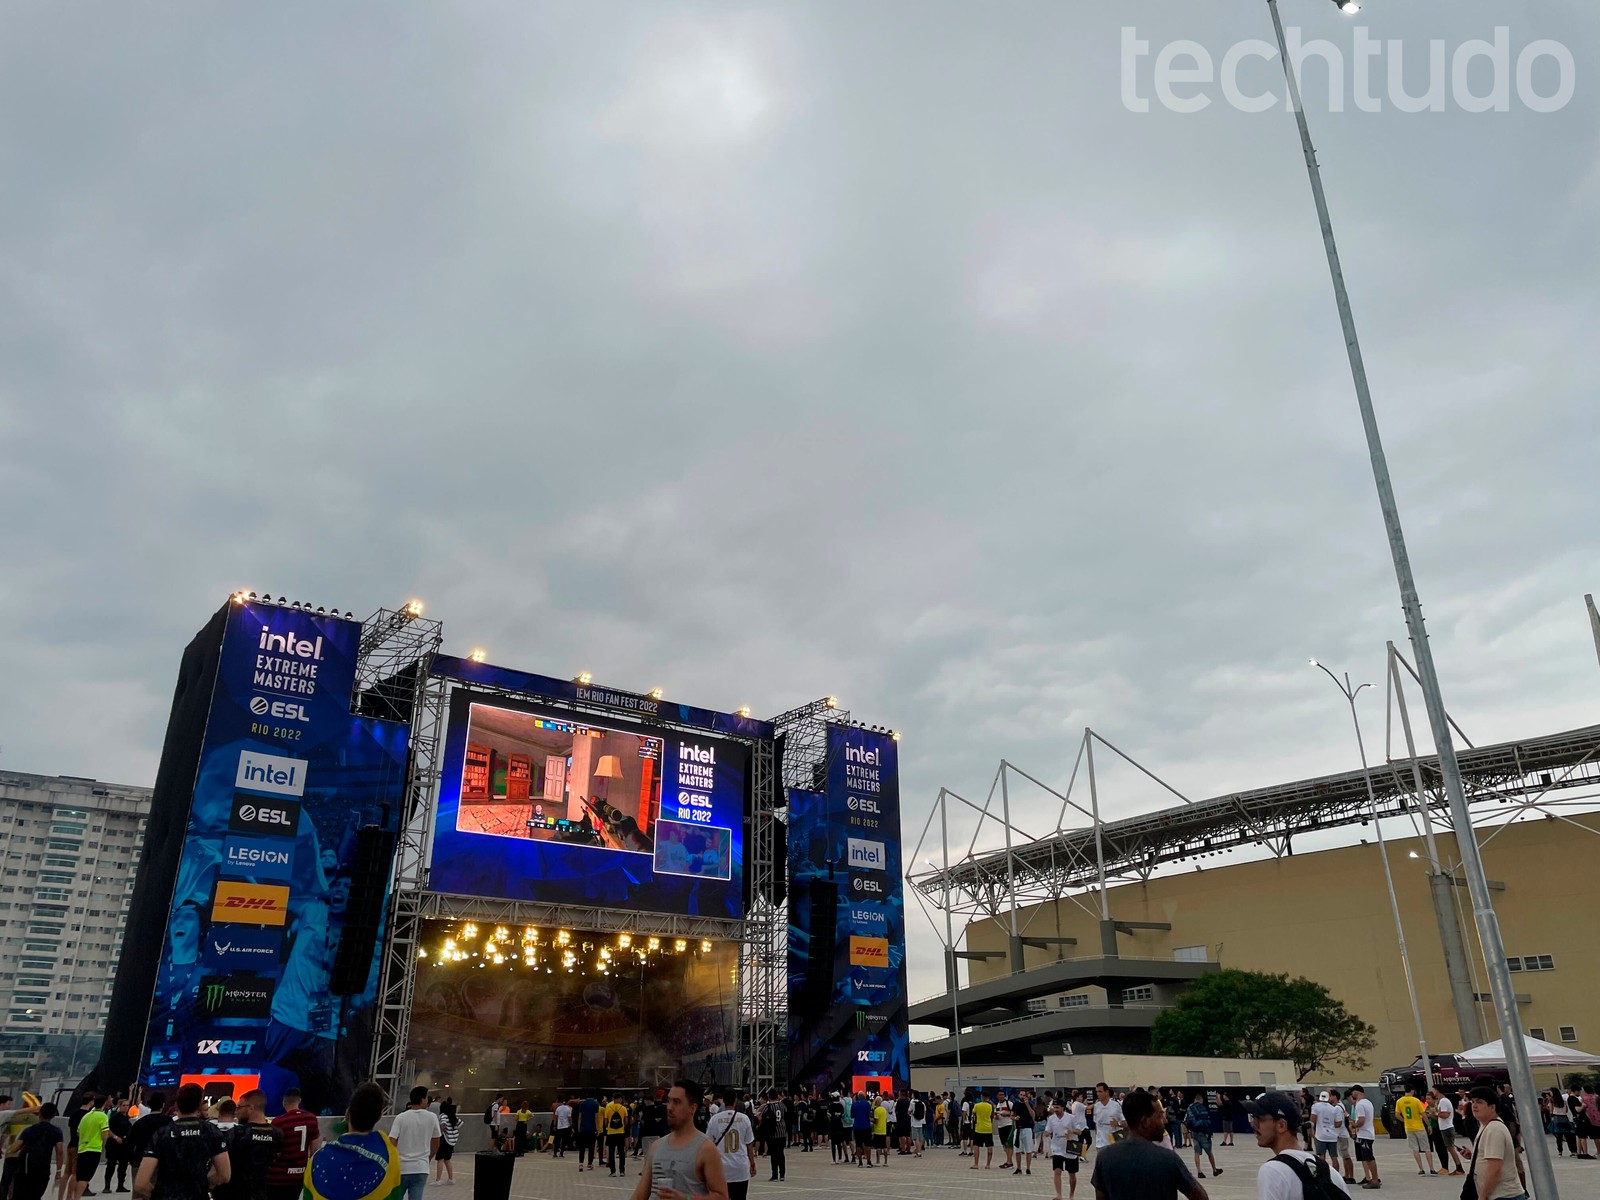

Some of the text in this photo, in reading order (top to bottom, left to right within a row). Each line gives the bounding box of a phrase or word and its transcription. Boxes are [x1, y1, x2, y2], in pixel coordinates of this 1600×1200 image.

[259, 626, 322, 660] intel
[256, 655, 318, 678] EXTREME
[253, 672, 315, 694] MASTERS
[576, 688, 657, 712] IEM RIO FAN FEST 2022
[271, 702, 310, 722] ESL
[251, 723, 302, 740] RIO 2022
[680, 742, 714, 764] intel
[845, 742, 880, 766] intel
[244, 760, 295, 787] intel
[679, 763, 713, 778] EXTREME
[846, 764, 880, 781] EXTREME
[679, 774, 713, 788] MASTERS
[846, 777, 880, 792] MASTERS
[691, 794, 712, 808] ESL
[859, 802, 880, 814] ESL
[258, 808, 291, 826] ESL
[678, 807, 711, 822] RIO 2022
[850, 816, 878, 828] RIO 2022
[229, 847, 288, 864] LEGION
[852, 845, 879, 862] intel
[863, 881, 882, 892] ESL
[224, 896, 279, 910] DHL
[852, 910, 884, 922] LEGION
[855, 947, 883, 956] DHL
[225, 990, 267, 998] MONSTER
[197, 1040, 256, 1054] 1XBET
[858, 1050, 887, 1062] 1XBET
[775, 1109, 781, 1122] 9
[1405, 1106, 1412, 1119] 9
[294, 1125, 307, 1152] 7
[723, 1128, 740, 1154] 10
